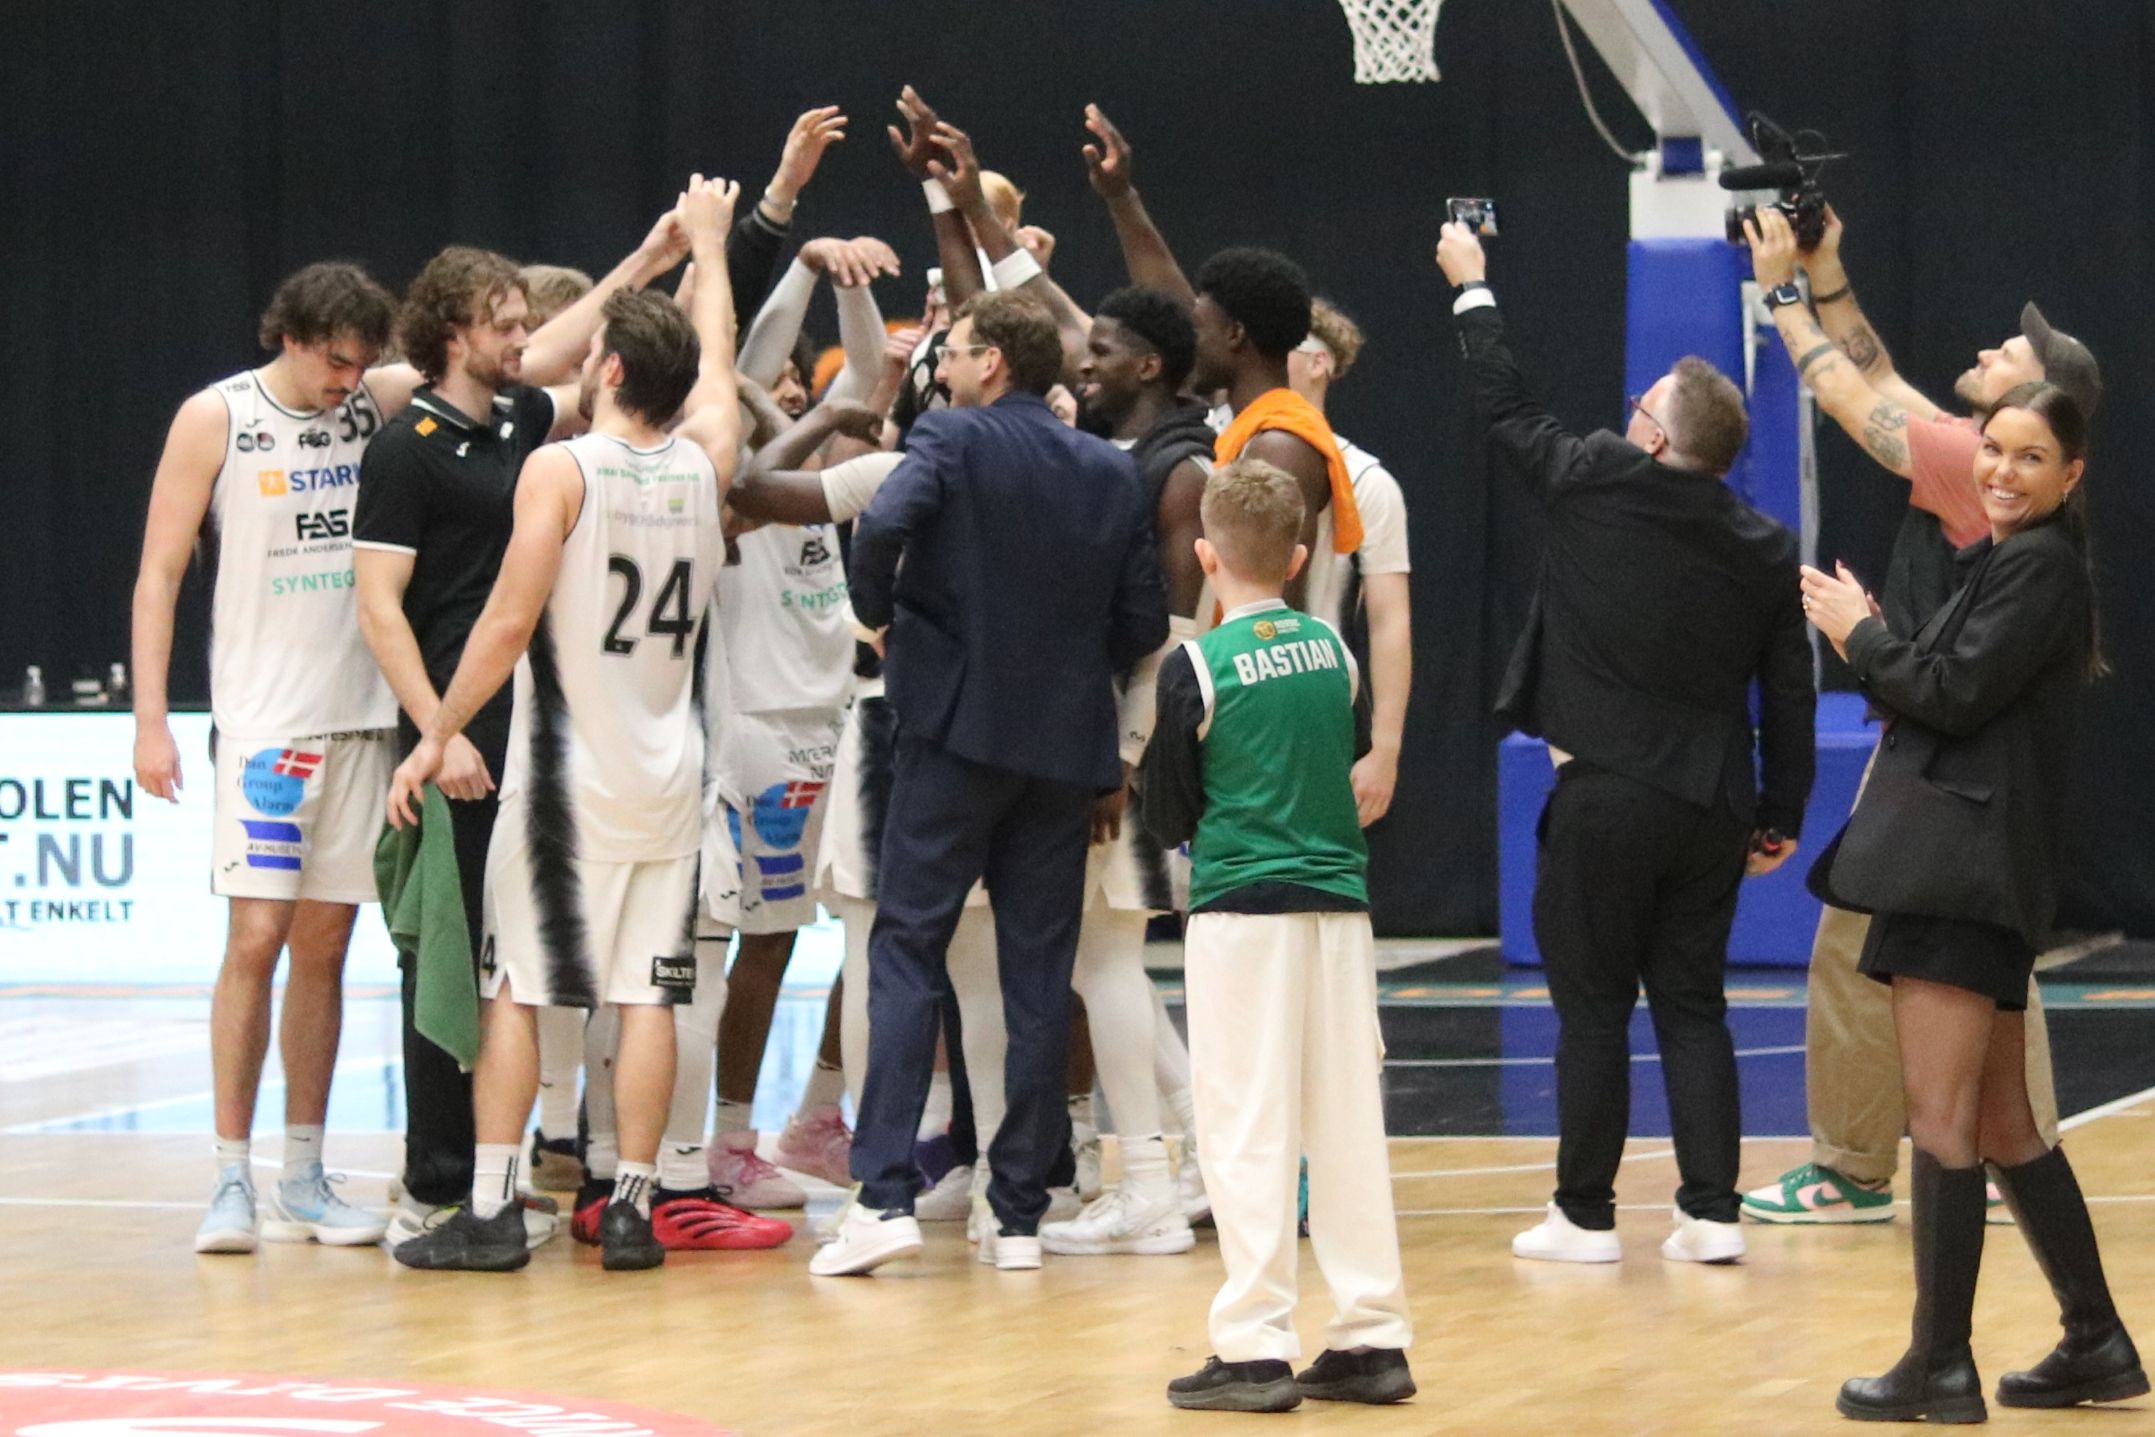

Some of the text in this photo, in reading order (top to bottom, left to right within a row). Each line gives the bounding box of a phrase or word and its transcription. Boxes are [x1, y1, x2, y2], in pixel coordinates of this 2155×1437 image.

[338, 392, 376, 442] 35
[601, 553, 698, 660] 24
[1233, 639, 1338, 686] BASTIAN
[31, 901, 133, 921] ENKELT
